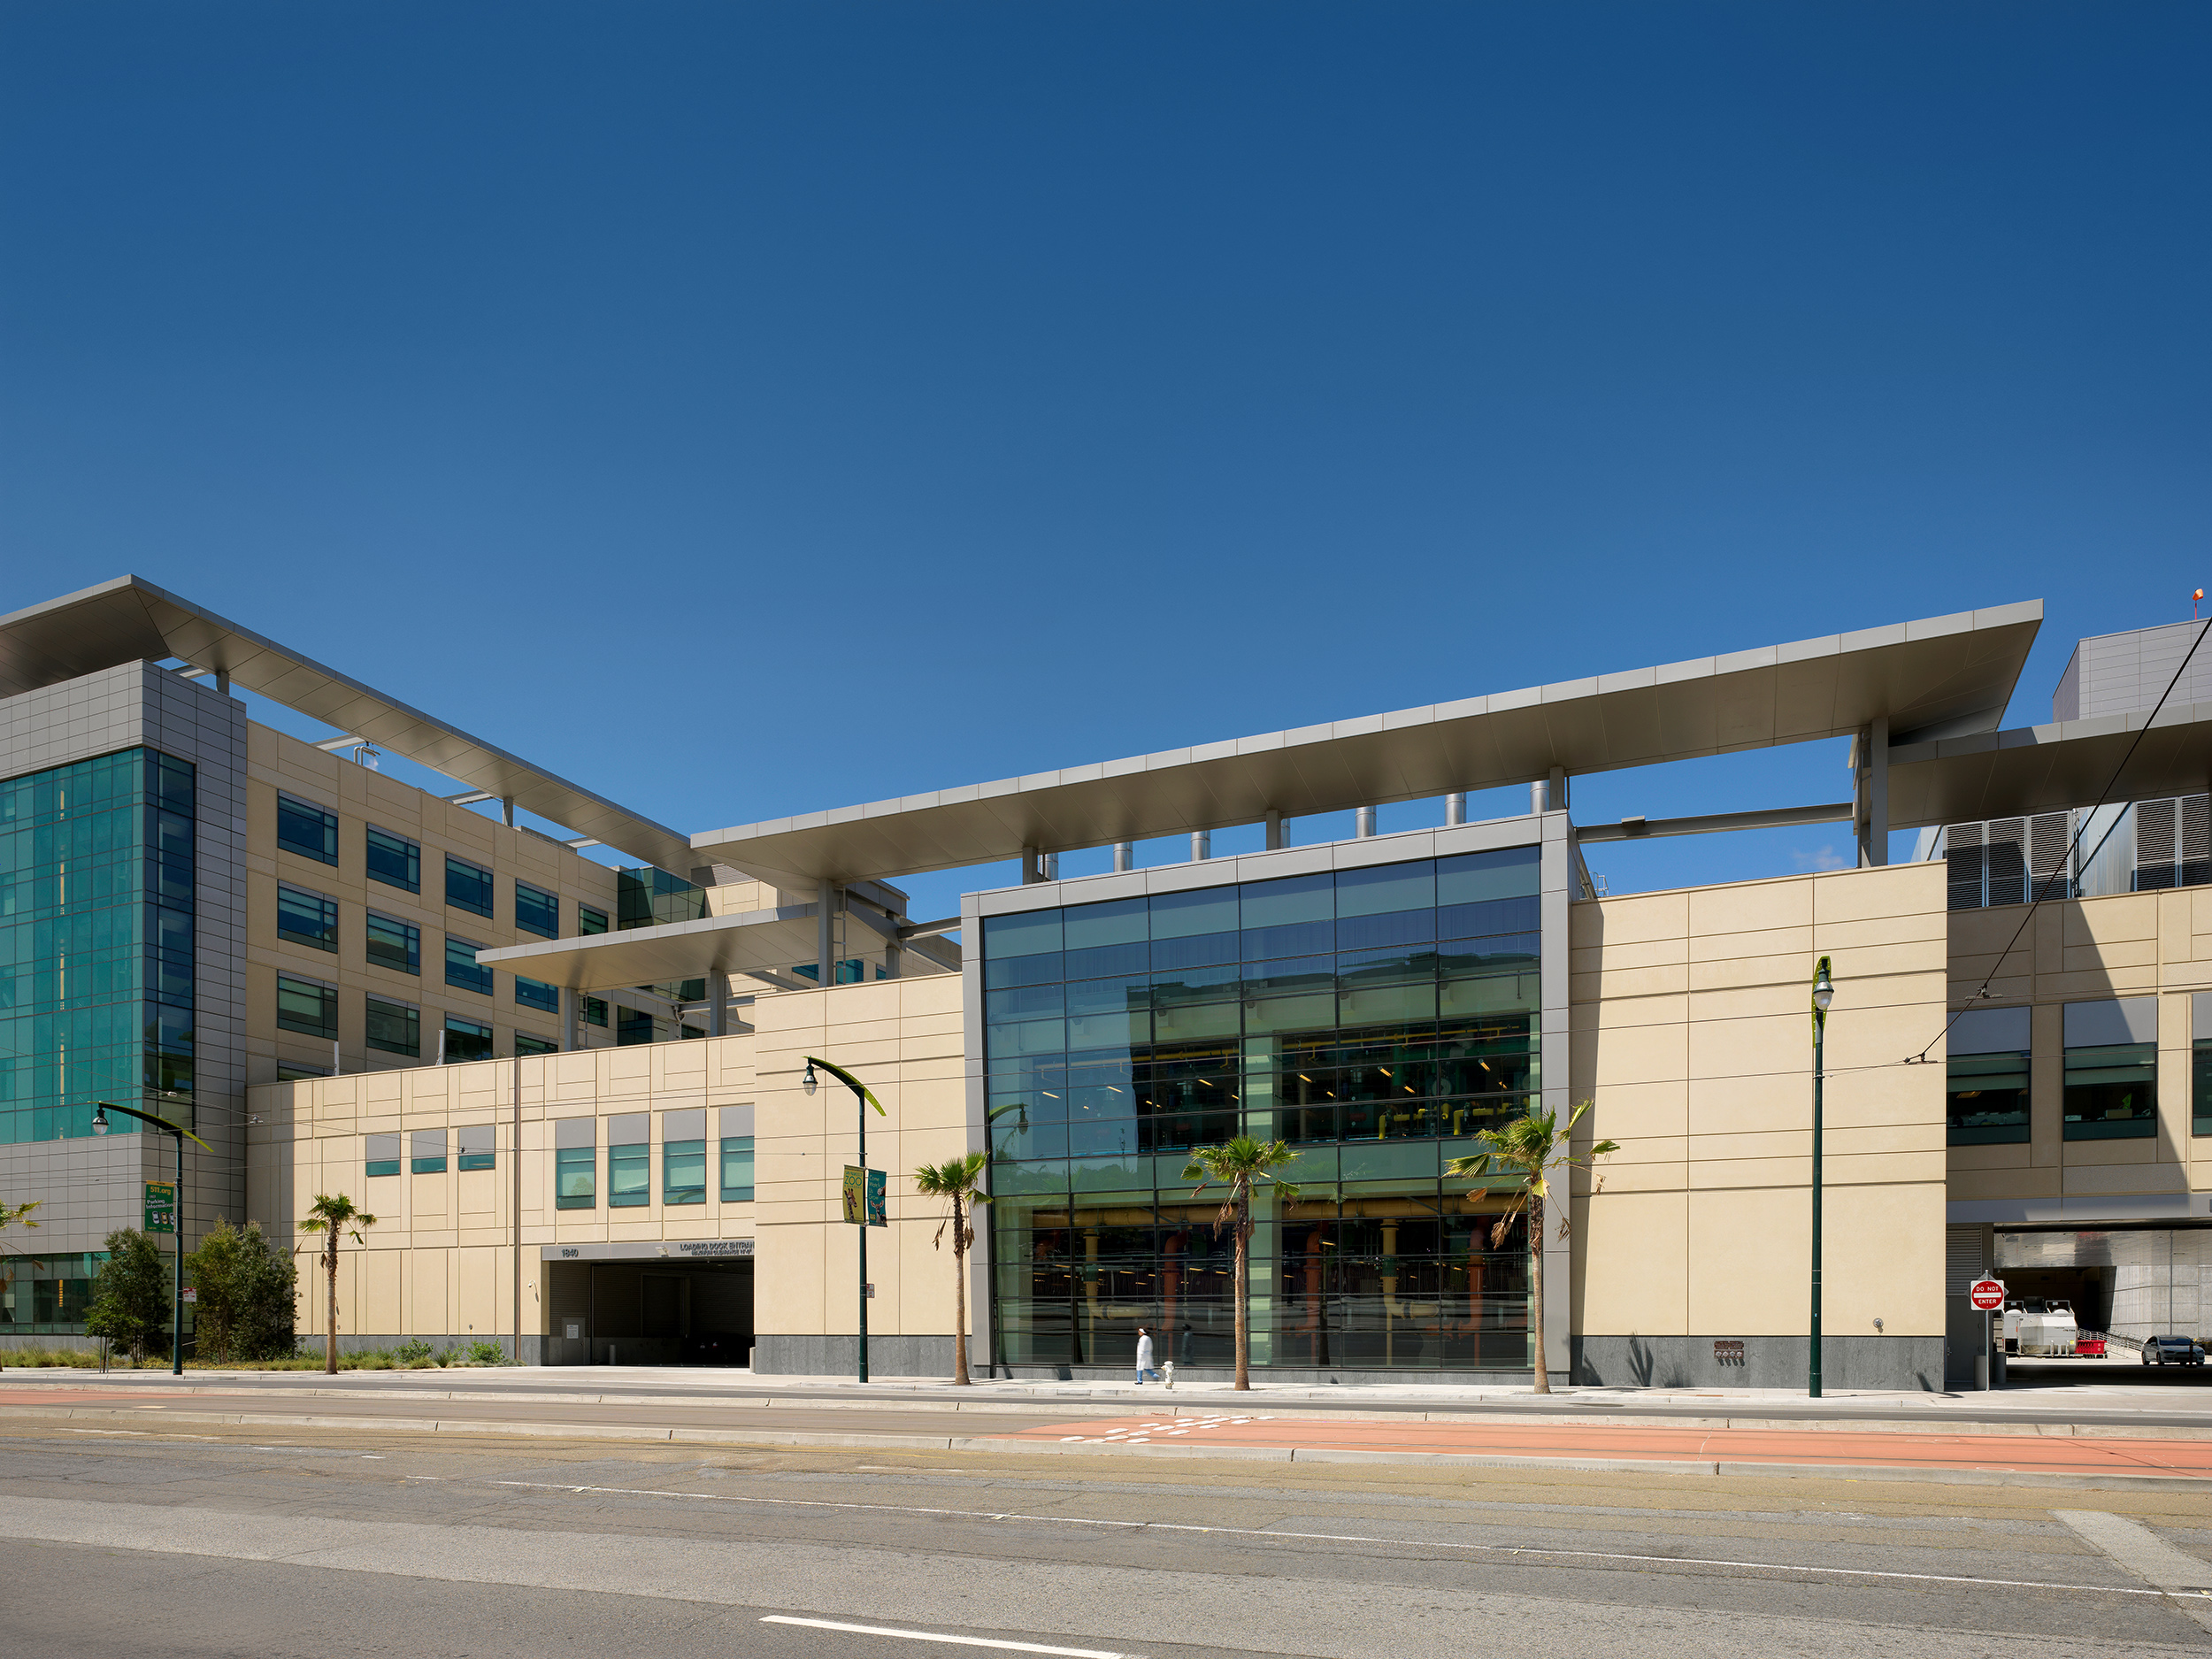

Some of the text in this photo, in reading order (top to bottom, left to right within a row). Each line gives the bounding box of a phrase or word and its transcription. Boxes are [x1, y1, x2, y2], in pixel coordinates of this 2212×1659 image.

[844, 1175, 863, 1187] ZOO
[150, 1186, 171, 1195] 511.org
[561, 1248, 580, 1258] 1840
